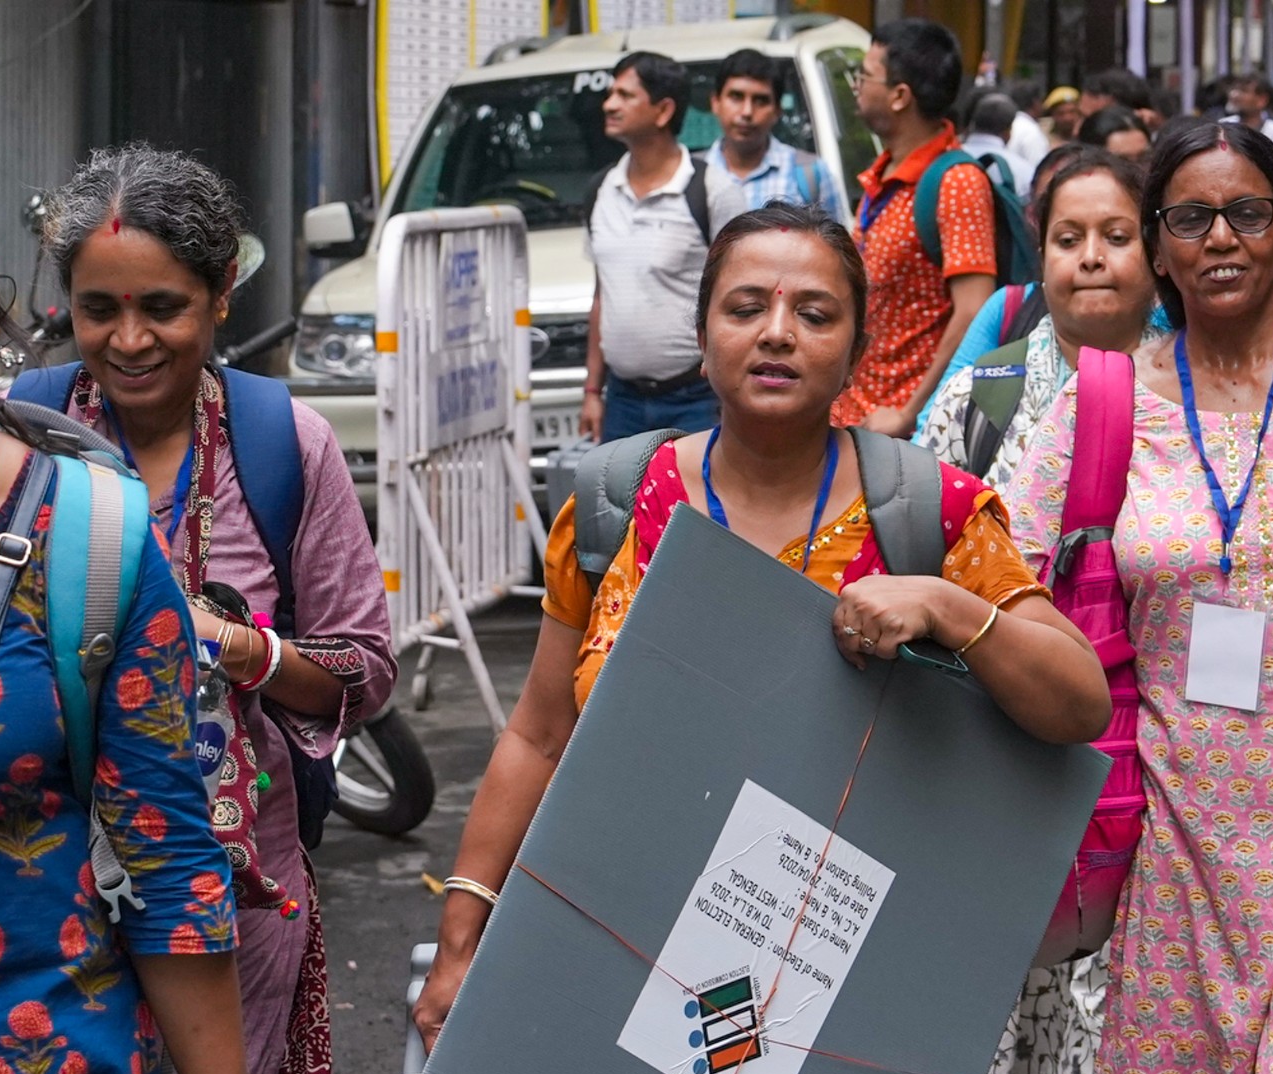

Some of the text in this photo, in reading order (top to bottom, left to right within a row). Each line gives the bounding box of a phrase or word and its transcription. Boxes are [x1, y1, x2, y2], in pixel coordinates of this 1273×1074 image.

[196, 741, 222, 763] nley
[782, 833, 805, 855] Name
[728, 868, 758, 896] BENGAL
[825, 860, 852, 886] Station
[755, 888, 778, 910] WEST
[824, 884, 842, 903] Poll
[851, 874, 877, 902] Polling
[799, 891, 822, 913] Name
[838, 894, 851, 906] of
[849, 899, 869, 920] Date
[694, 896, 733, 927] ELECTION
[760, 914, 773, 930] TO
[781, 904, 795, 920] UT
[830, 909, 843, 927] No.
[732, 917, 765, 948] GENERAL
[797, 914, 821, 936] State
[817, 927, 830, 939] of
[843, 918, 861, 936] A.C.
[829, 932, 851, 955] Name
[772, 944, 803, 972] Election
[800, 963, 812, 975] of
[701, 973, 728, 988] COMMISSION
[728, 964, 750, 978] ELECTION
[811, 968, 834, 990] Name
